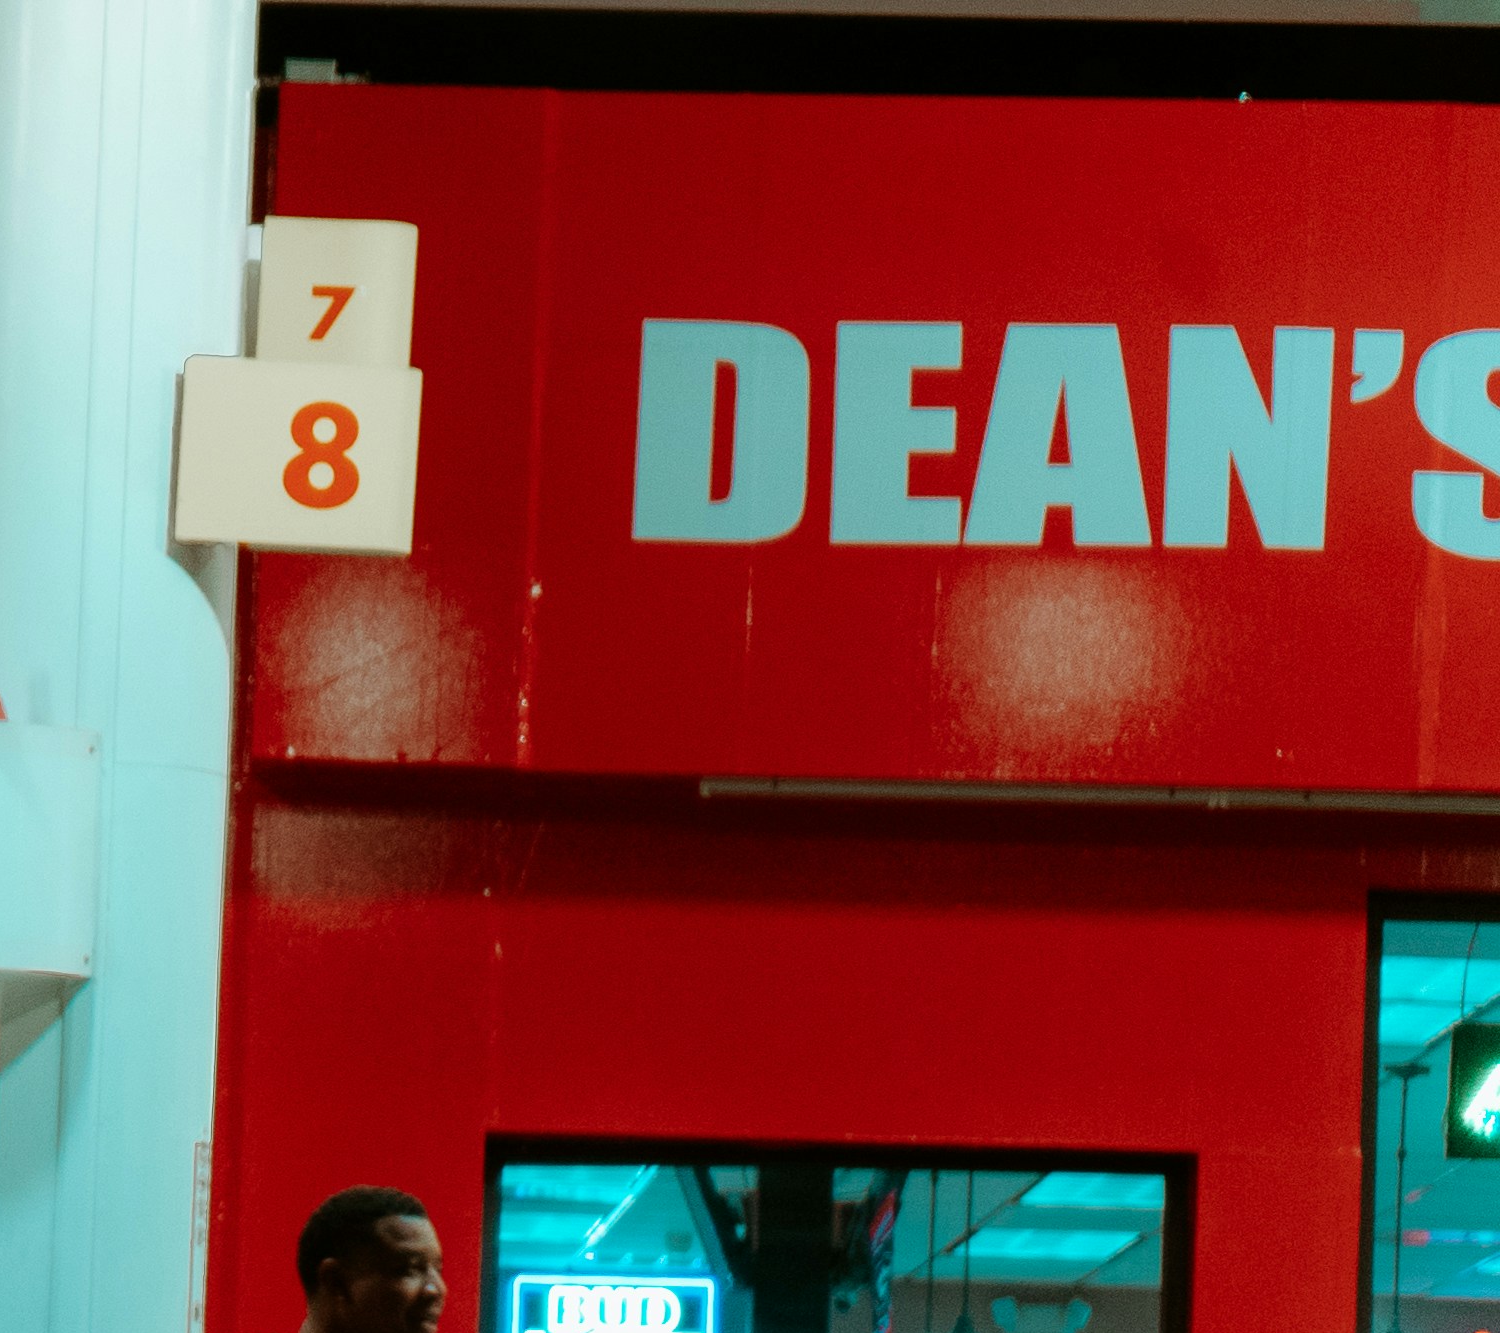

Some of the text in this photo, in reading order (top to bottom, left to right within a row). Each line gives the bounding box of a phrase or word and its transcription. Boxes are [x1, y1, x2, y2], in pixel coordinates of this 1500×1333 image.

[308, 286, 355, 341] 7
[281, 401, 360, 510] 8
[631, 317, 1500, 561] DEAN'S
[548, 1285, 681, 1333] BUD
